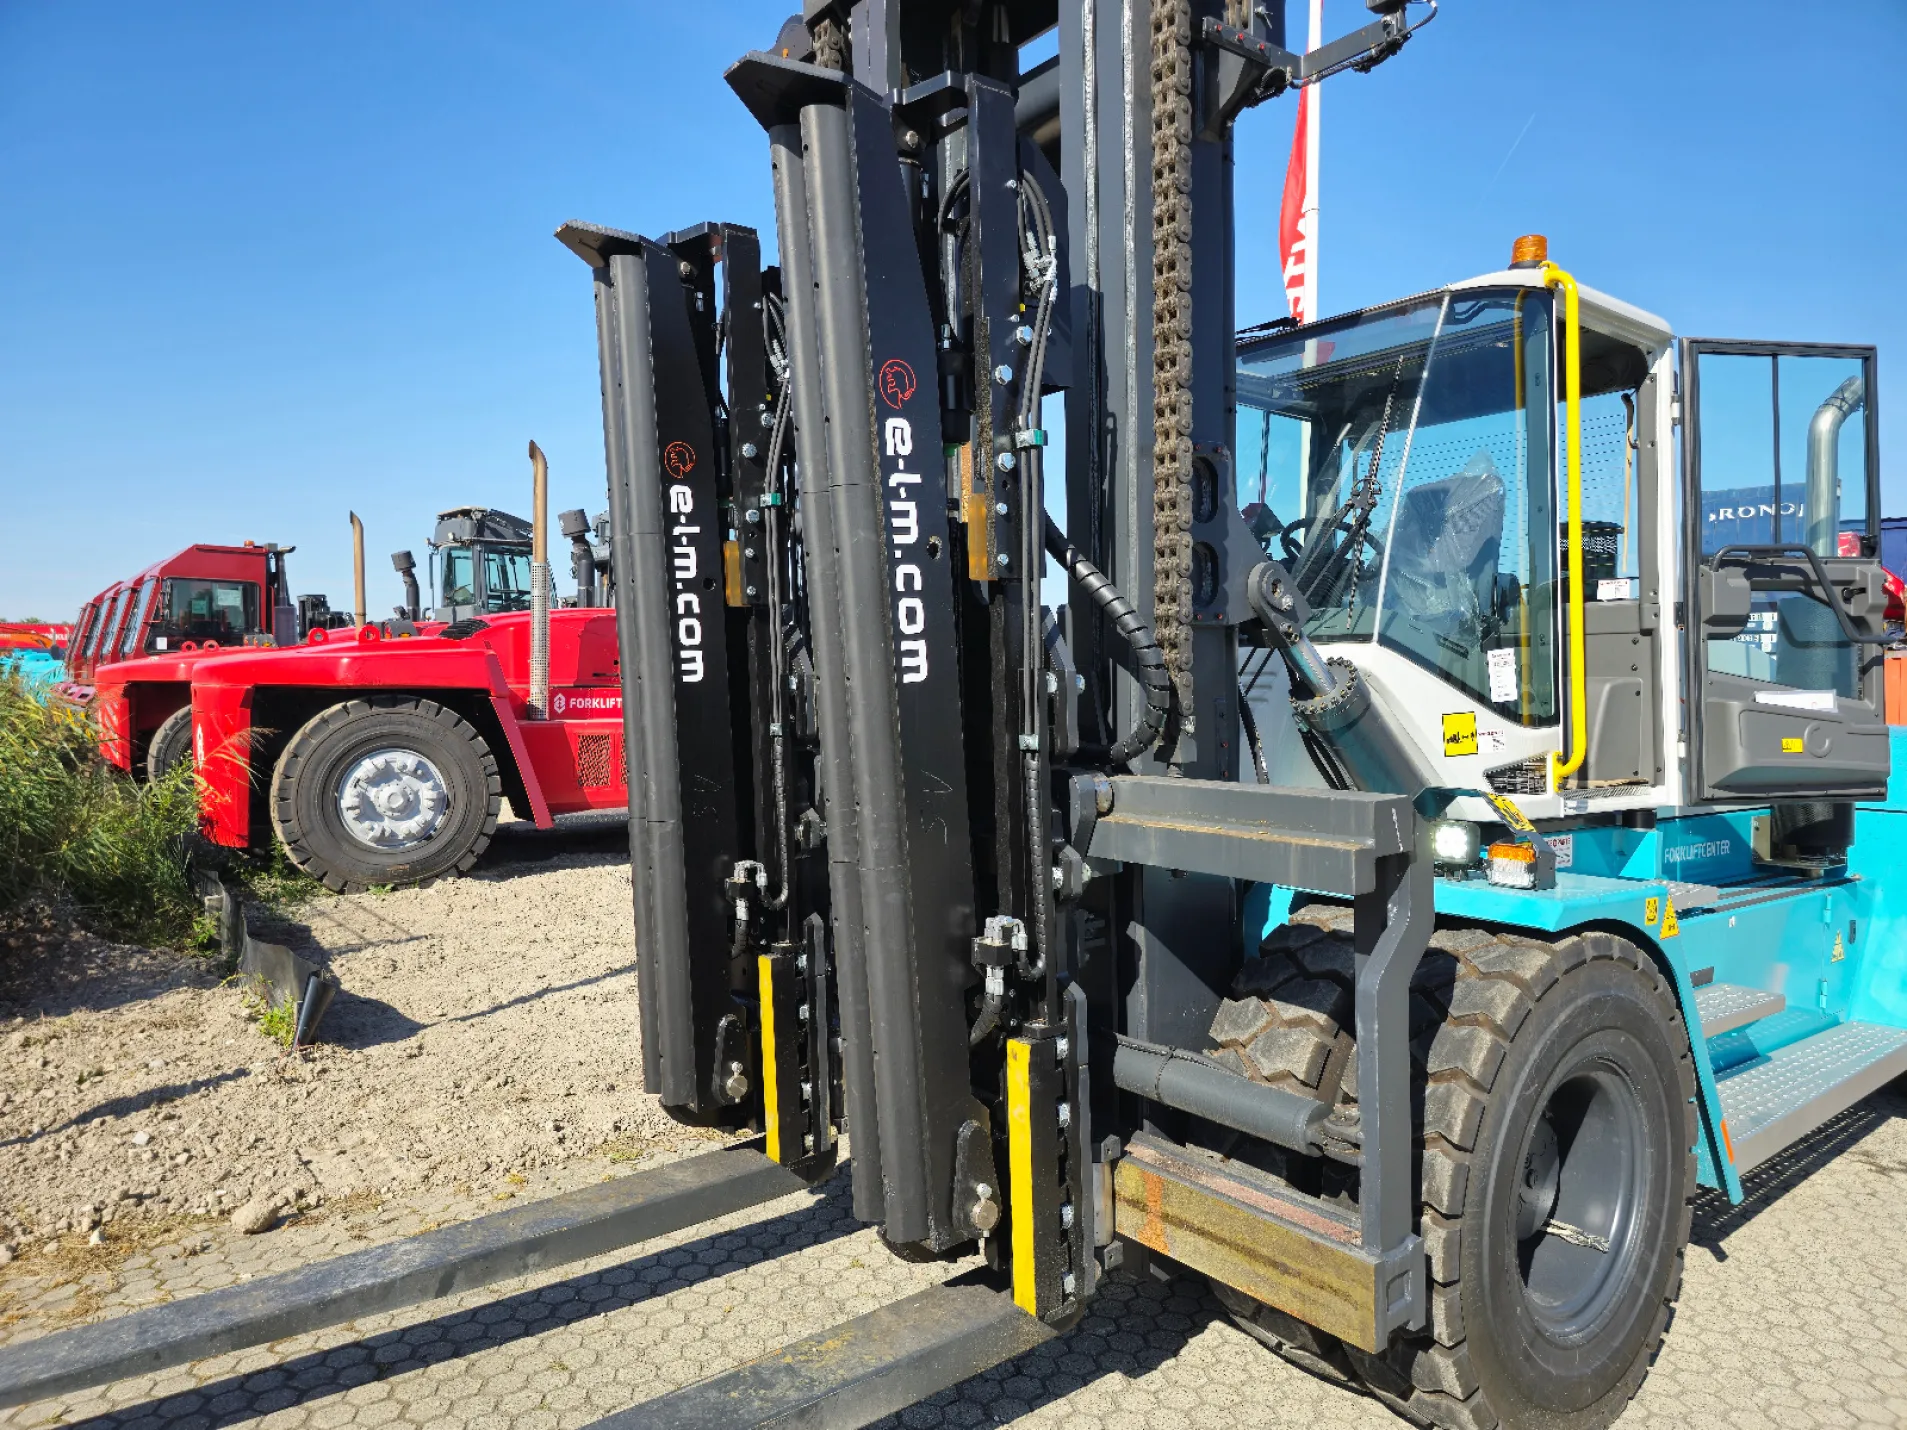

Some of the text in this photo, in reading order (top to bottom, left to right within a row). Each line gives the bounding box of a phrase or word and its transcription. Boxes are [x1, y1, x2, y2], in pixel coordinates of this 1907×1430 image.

[670, 485, 703, 682] e-l-m.com
[885, 417, 928, 684] e-l-m.com
[1664, 839, 1731, 864] FORKLIFTCENTER
